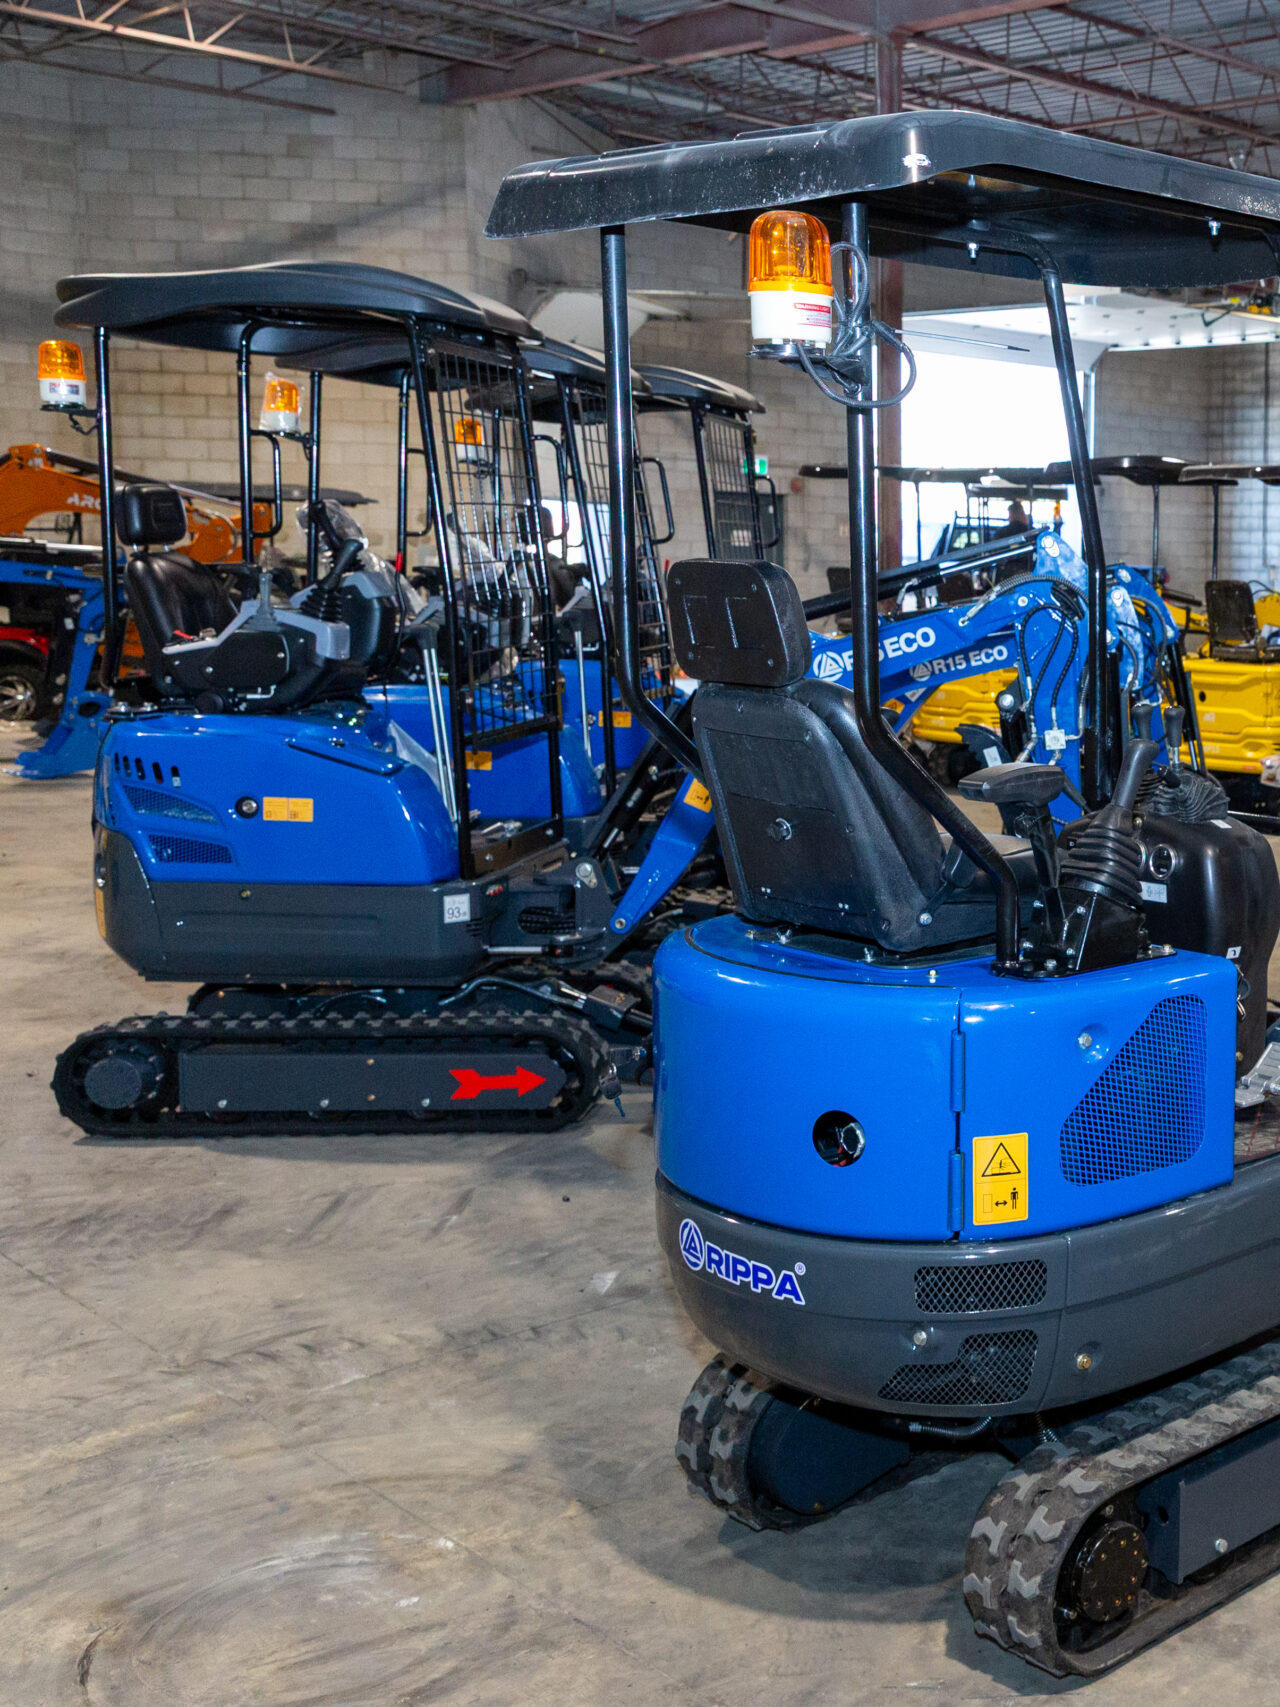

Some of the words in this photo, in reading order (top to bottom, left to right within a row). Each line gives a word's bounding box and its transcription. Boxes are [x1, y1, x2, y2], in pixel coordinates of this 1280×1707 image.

[883, 626, 936, 660] ECO
[933, 654, 967, 675] R15
[968, 645, 1008, 668] ECO
